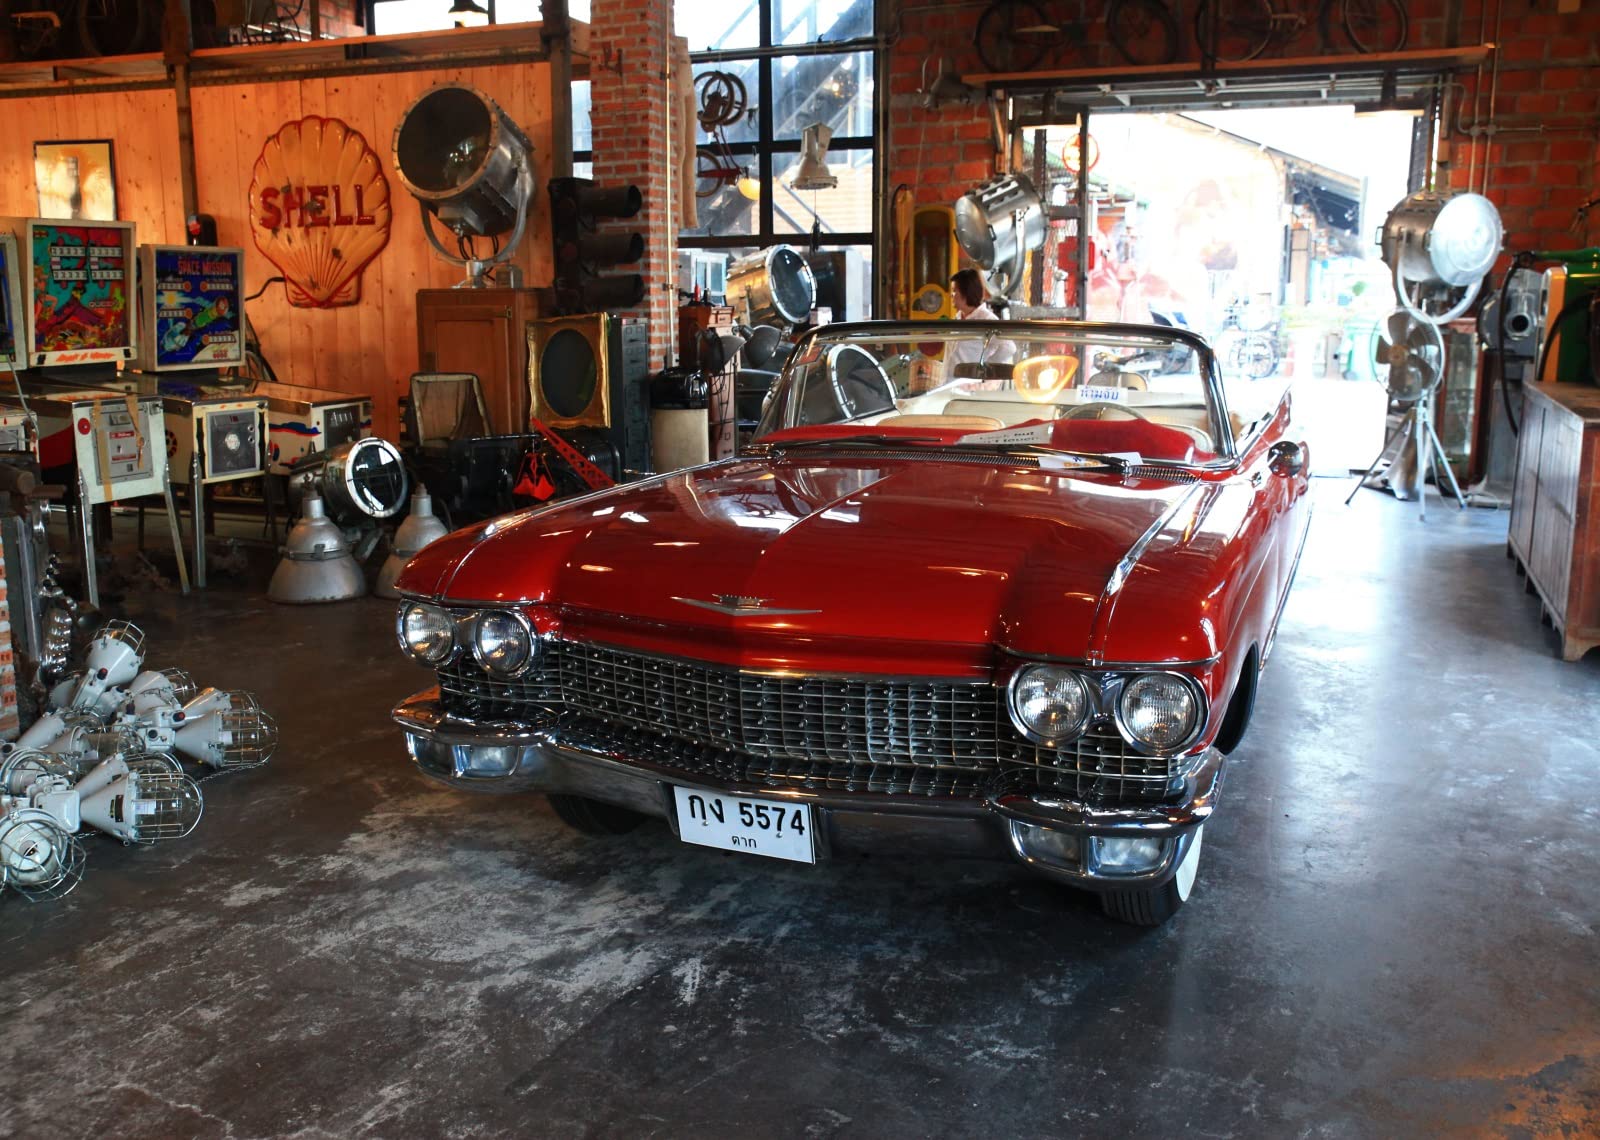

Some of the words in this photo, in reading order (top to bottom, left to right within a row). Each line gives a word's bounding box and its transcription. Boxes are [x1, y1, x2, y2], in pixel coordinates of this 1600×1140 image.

[259, 184, 376, 229] SHELL
[178, 259, 200, 274] SPACE
[202, 260, 232, 275] MISSION
[739, 802, 805, 835] 5574
[731, 835, 757, 848] ตาก
